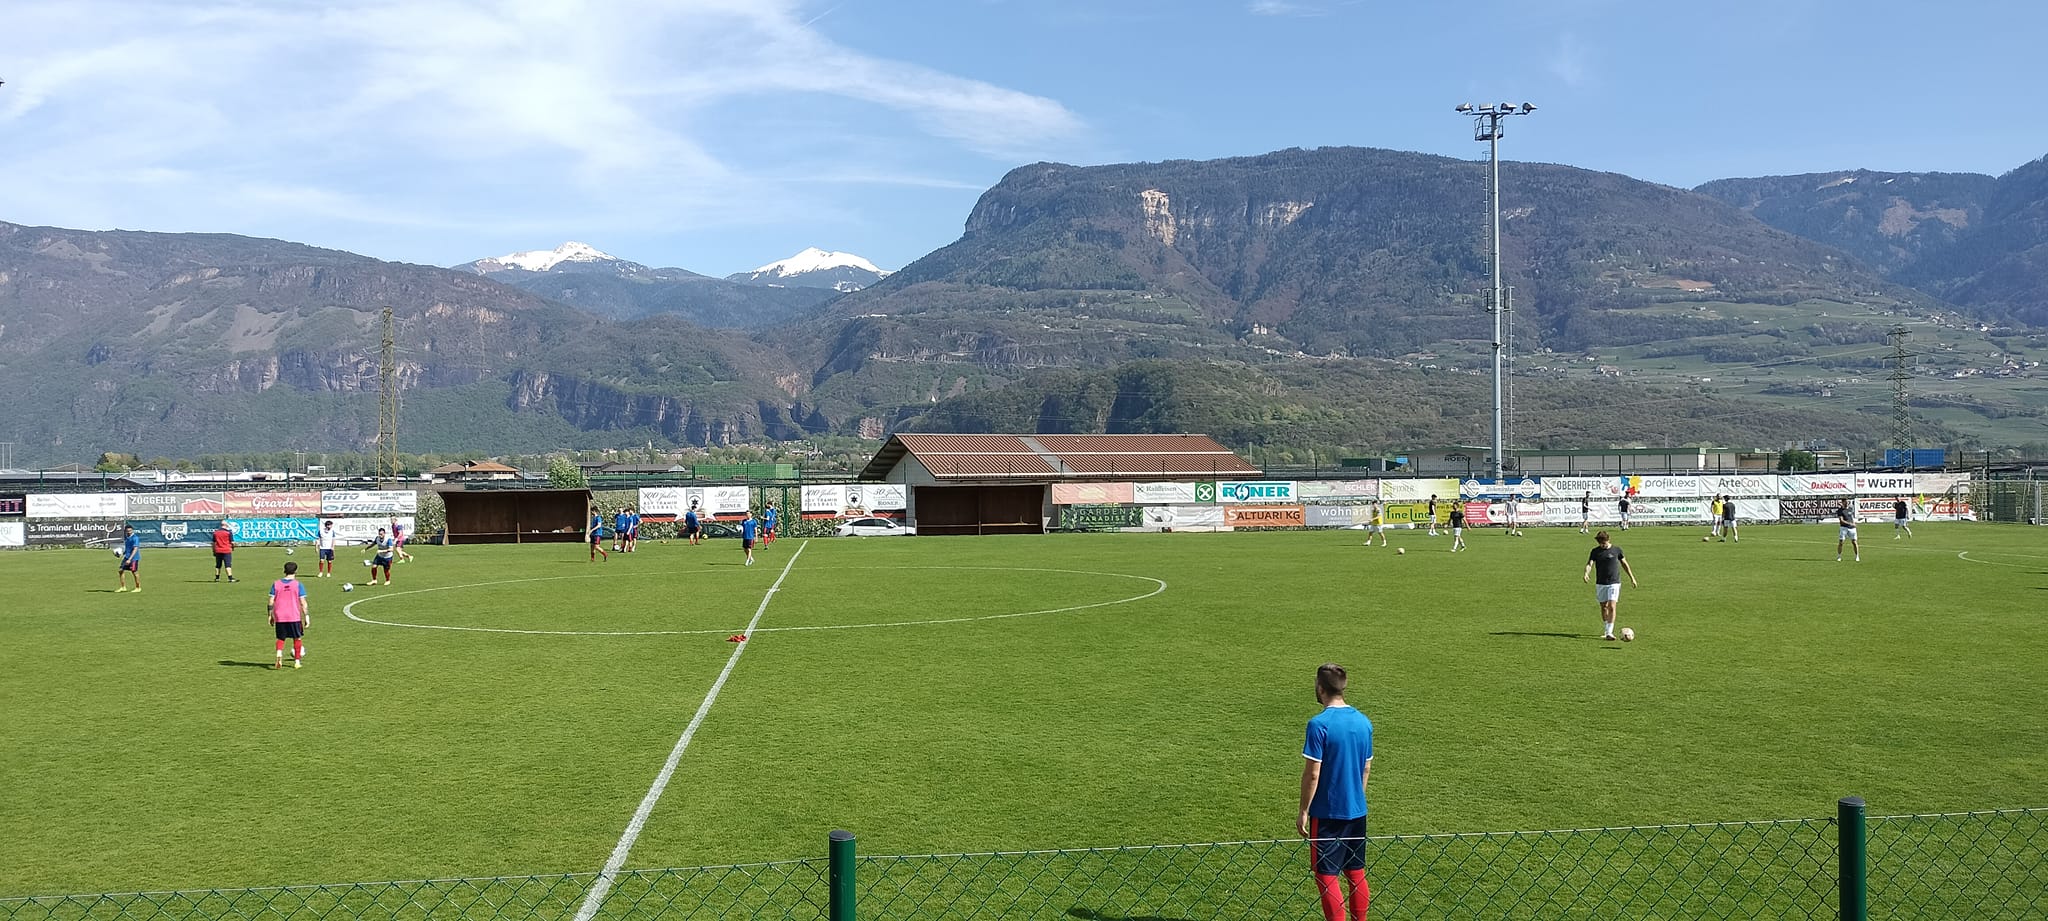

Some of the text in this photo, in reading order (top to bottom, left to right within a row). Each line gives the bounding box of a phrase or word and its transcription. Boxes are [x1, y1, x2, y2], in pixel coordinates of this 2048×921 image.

[1557, 480, 1602, 490] OBERHOFER
[1645, 478, 1696, 489] profiklexs
[1718, 478, 1760, 488] ArteCon
[1868, 478, 1912, 489] WÜRTH
[1222, 484, 1289, 501] RONER
[132, 496, 176, 505] ZÖGGELER
[252, 496, 293, 509] Girardi
[158, 505, 177, 513] BAU
[1320, 507, 1369, 516] wohnart
[1228, 509, 1283, 520] SALTUARI
[1286, 511, 1300, 519] KG
[73, 523, 122, 533] Weinhaus
[242, 521, 298, 530] ELEKTRO
[339, 524, 368, 532] PETER
[242, 529, 317, 539] BACHMANN
